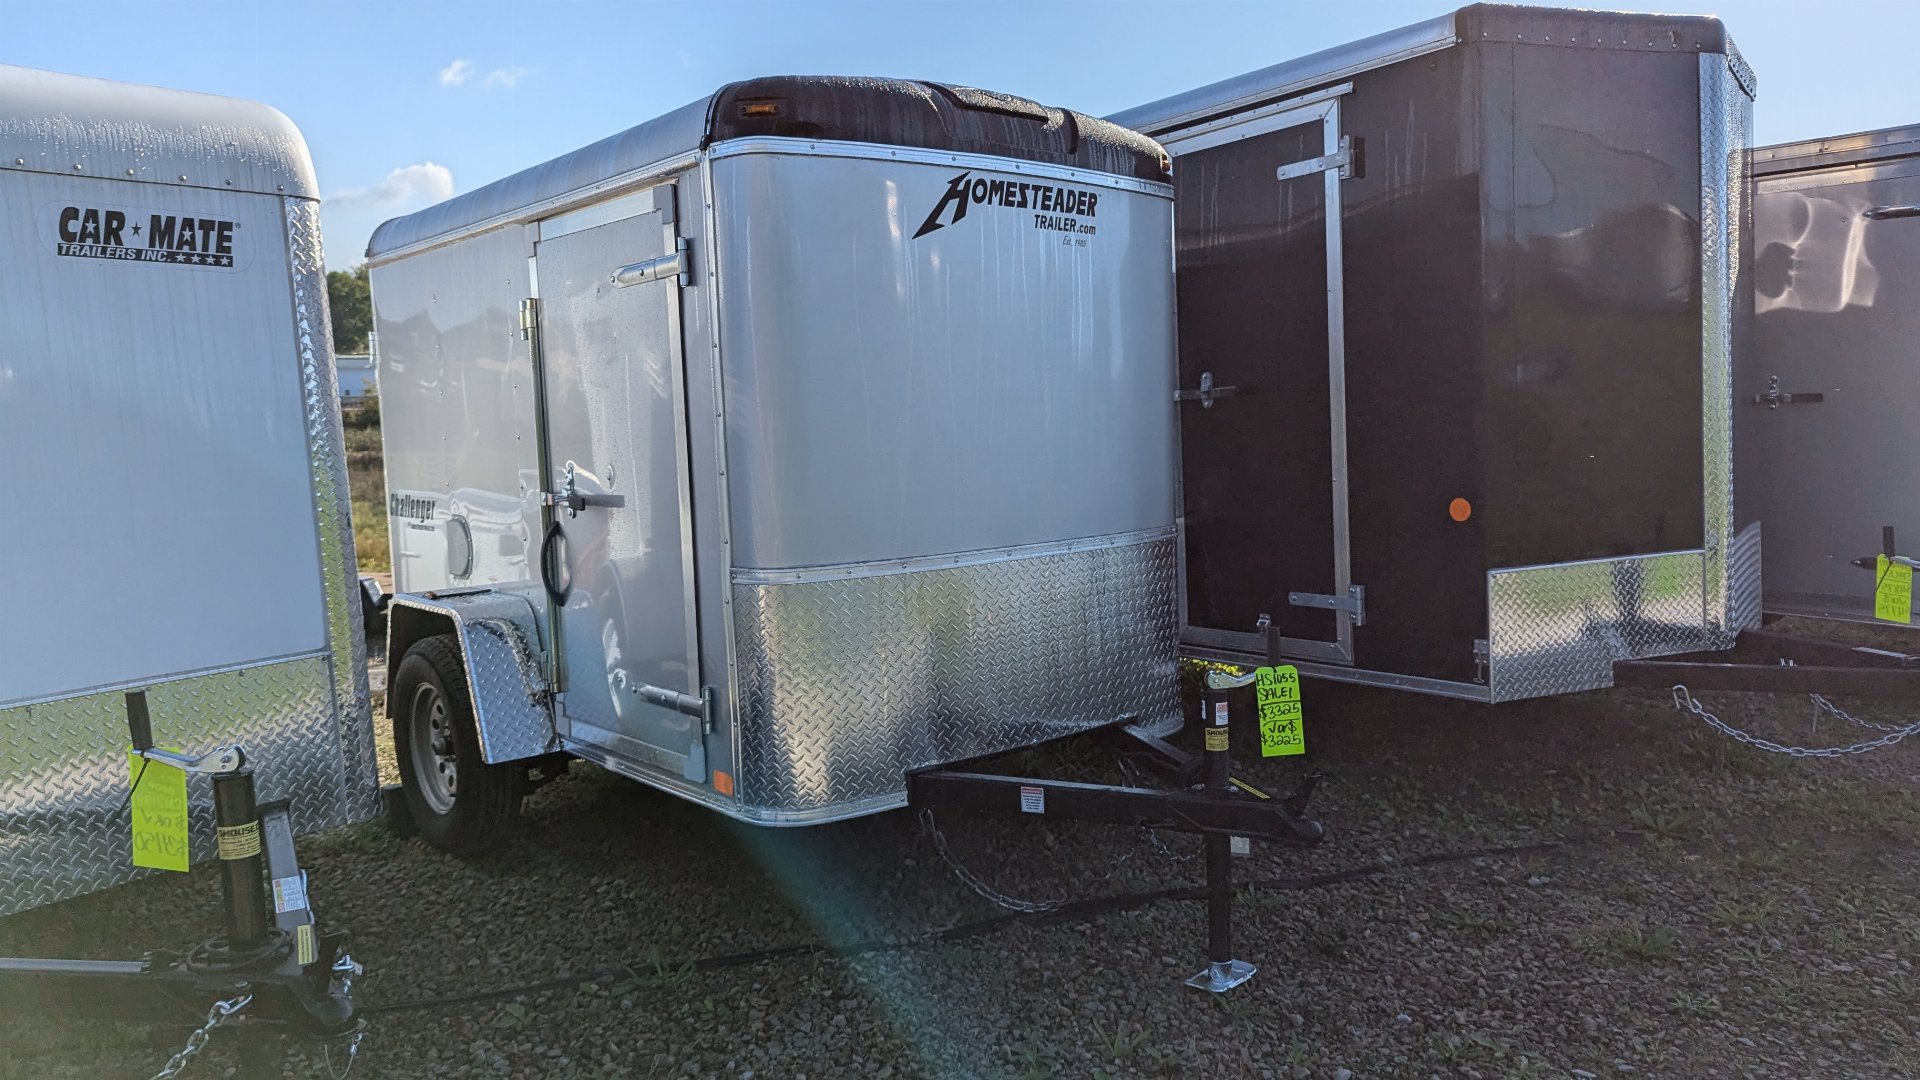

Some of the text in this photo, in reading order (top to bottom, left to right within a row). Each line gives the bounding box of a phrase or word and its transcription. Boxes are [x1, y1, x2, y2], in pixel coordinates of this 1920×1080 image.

[912, 171, 1098, 240] HOMESTEADER
[59, 206, 234, 254] CAR MATE
[1034, 214, 1096, 236] TRAILER.com
[60, 243, 172, 263] TRAILERS INC.
[391, 493, 437, 523] Challenger
[1256, 672, 1297, 687] HS1055
[1259, 703, 1300, 721] $3325
[1261, 732, 1302, 747] $3225
